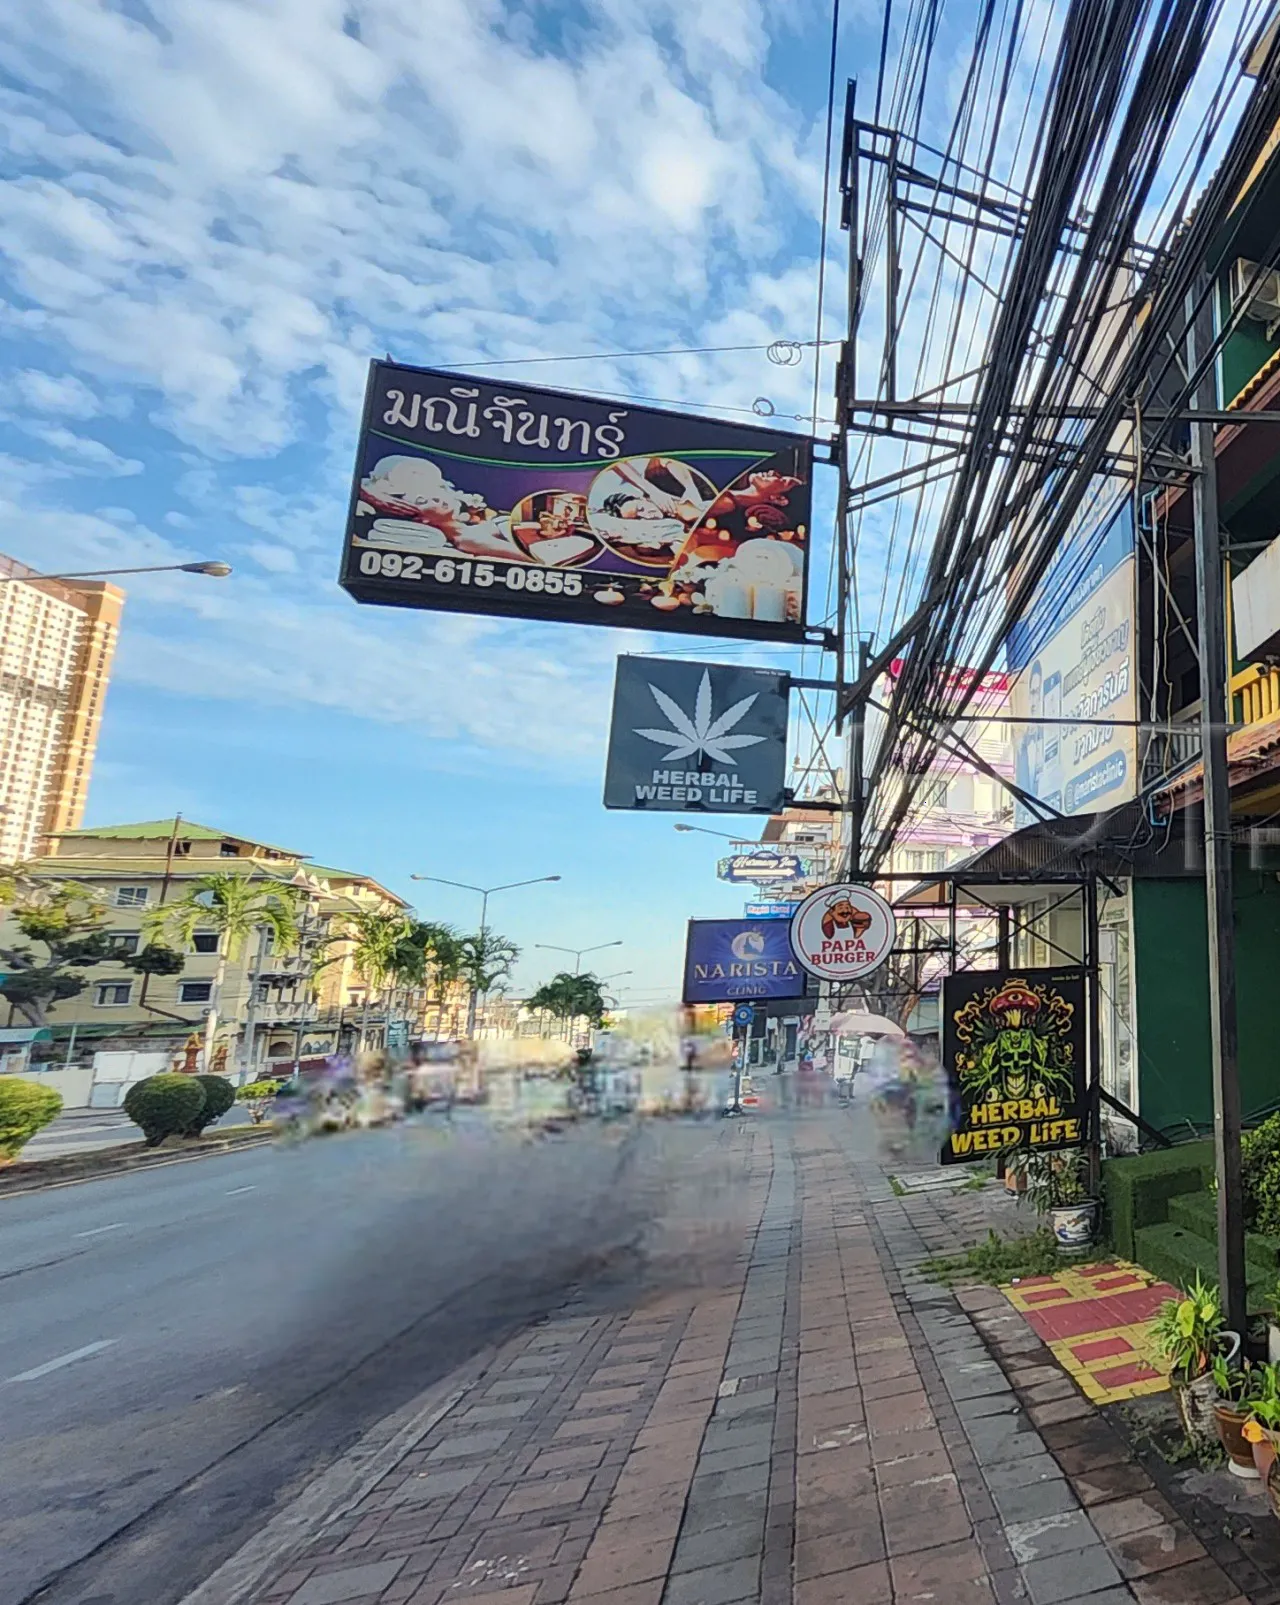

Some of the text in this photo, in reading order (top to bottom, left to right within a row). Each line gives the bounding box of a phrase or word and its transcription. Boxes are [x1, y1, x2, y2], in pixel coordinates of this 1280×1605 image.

[383, 387, 628, 458] มณีจันทร์
[359, 551, 583, 596] 092-615-0855
[652, 769, 744, 788] HERBAL
[635, 785, 758, 804] WEED LIFE
[821, 938, 867, 953] PAPA
[810, 951, 878, 966] BURGER
[693, 961, 799, 979] NARISTA
[726, 986, 767, 996] CLINIC
[970, 1096, 1060, 1124] HERBAL
[951, 1126, 1021, 1154] WEED
